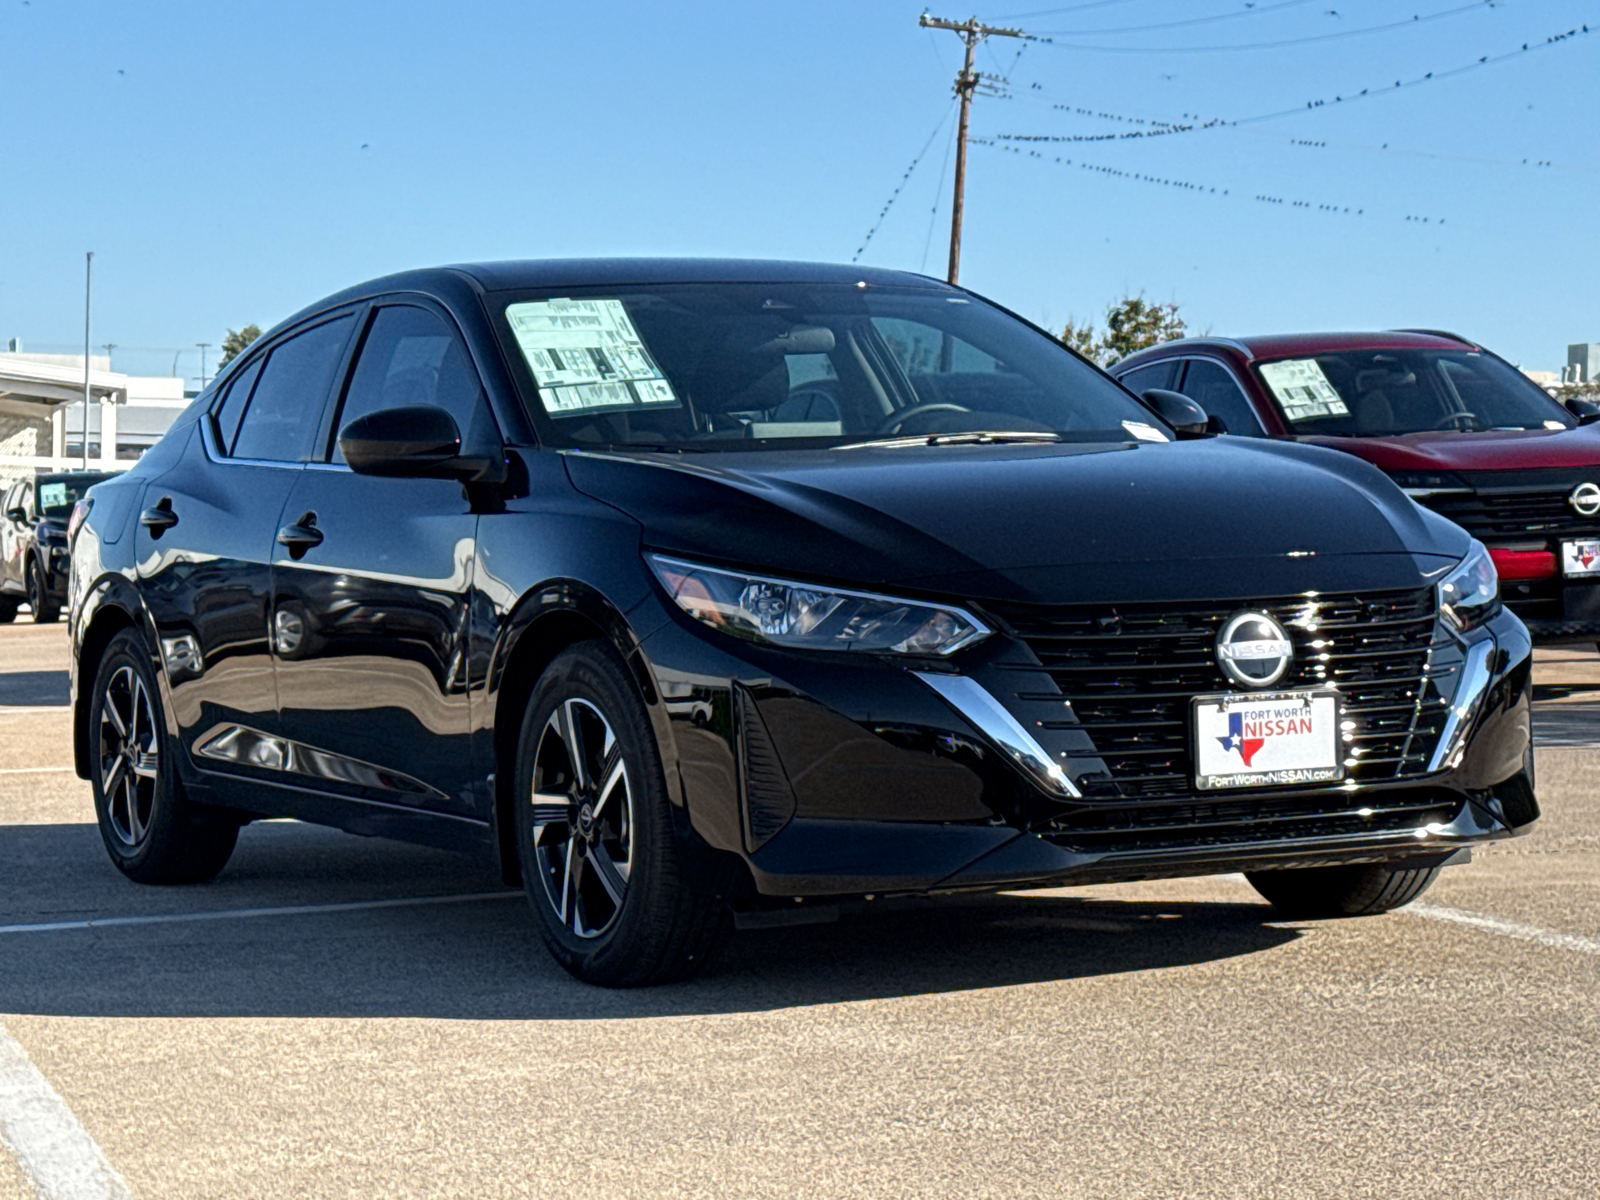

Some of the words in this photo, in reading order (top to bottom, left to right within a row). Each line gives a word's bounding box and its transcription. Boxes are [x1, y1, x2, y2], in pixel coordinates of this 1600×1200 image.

[1219, 644, 1290, 658] NISSAN
[1244, 709, 1271, 720] FORT
[1274, 706, 1312, 718] WORTH
[1245, 717, 1312, 737] NISSAN
